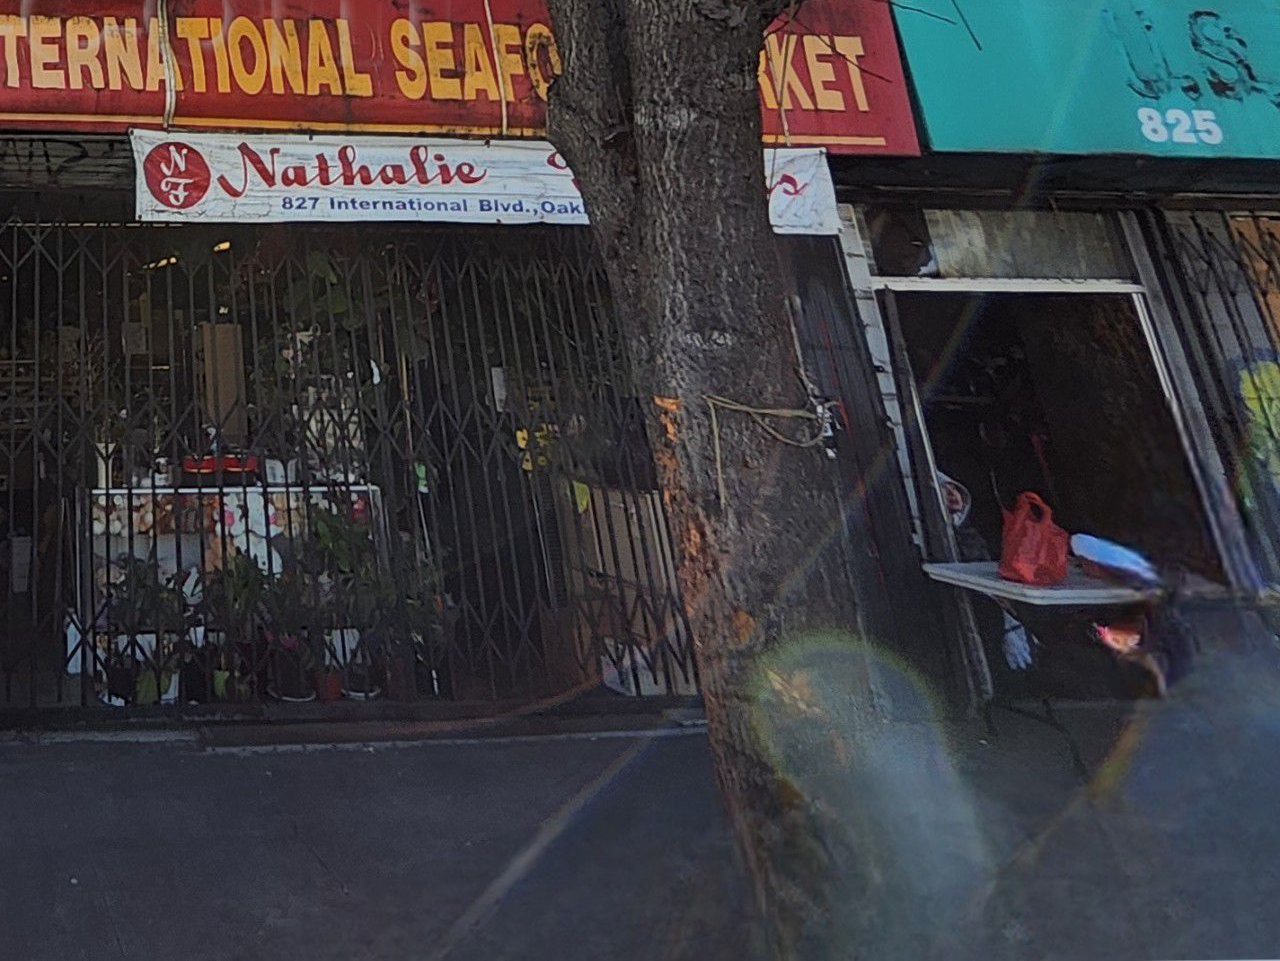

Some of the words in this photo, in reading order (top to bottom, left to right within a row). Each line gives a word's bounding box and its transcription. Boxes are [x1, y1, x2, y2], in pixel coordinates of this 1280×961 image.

[390, 17, 563, 104] SEAFO
[758, 33, 870, 112] KET
[1138, 107, 1223, 144] 825
[217, 141, 488, 198] Nathalie
[281, 197, 319, 210] 827
[329, 197, 468, 212] International
